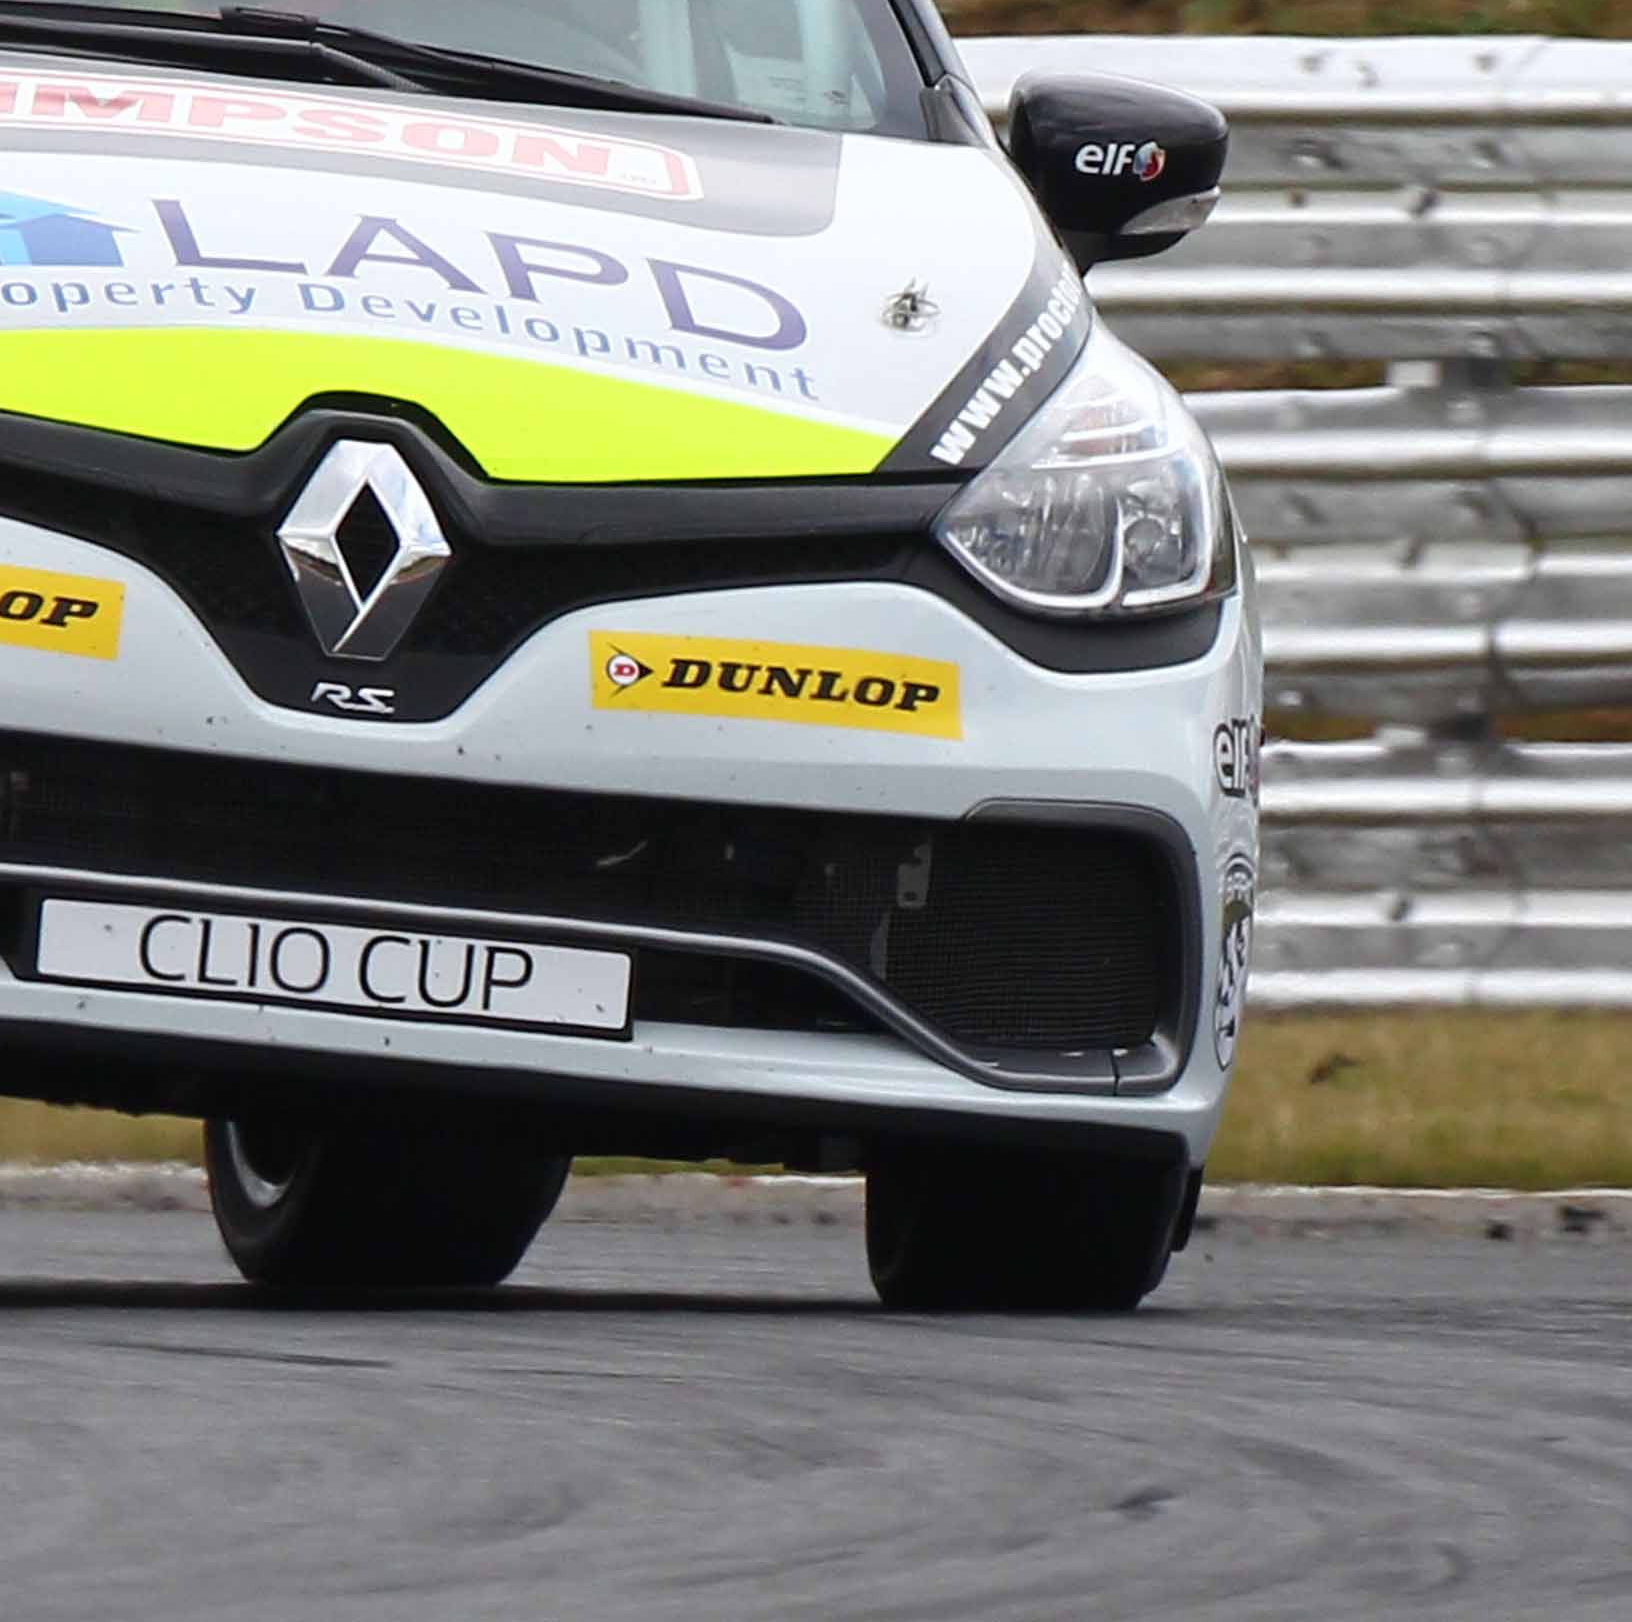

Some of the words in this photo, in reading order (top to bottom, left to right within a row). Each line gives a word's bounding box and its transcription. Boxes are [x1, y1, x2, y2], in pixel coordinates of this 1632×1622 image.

[1075, 142, 1134, 176] elf
[146, 197, 810, 354] LAPD
[301, 280, 823, 402] Development
[310, 681, 396, 715] RS
[662, 658, 940, 712] DUNLOP
[138, 913, 332, 995] CLIO
[358, 935, 535, 1012] CUP
